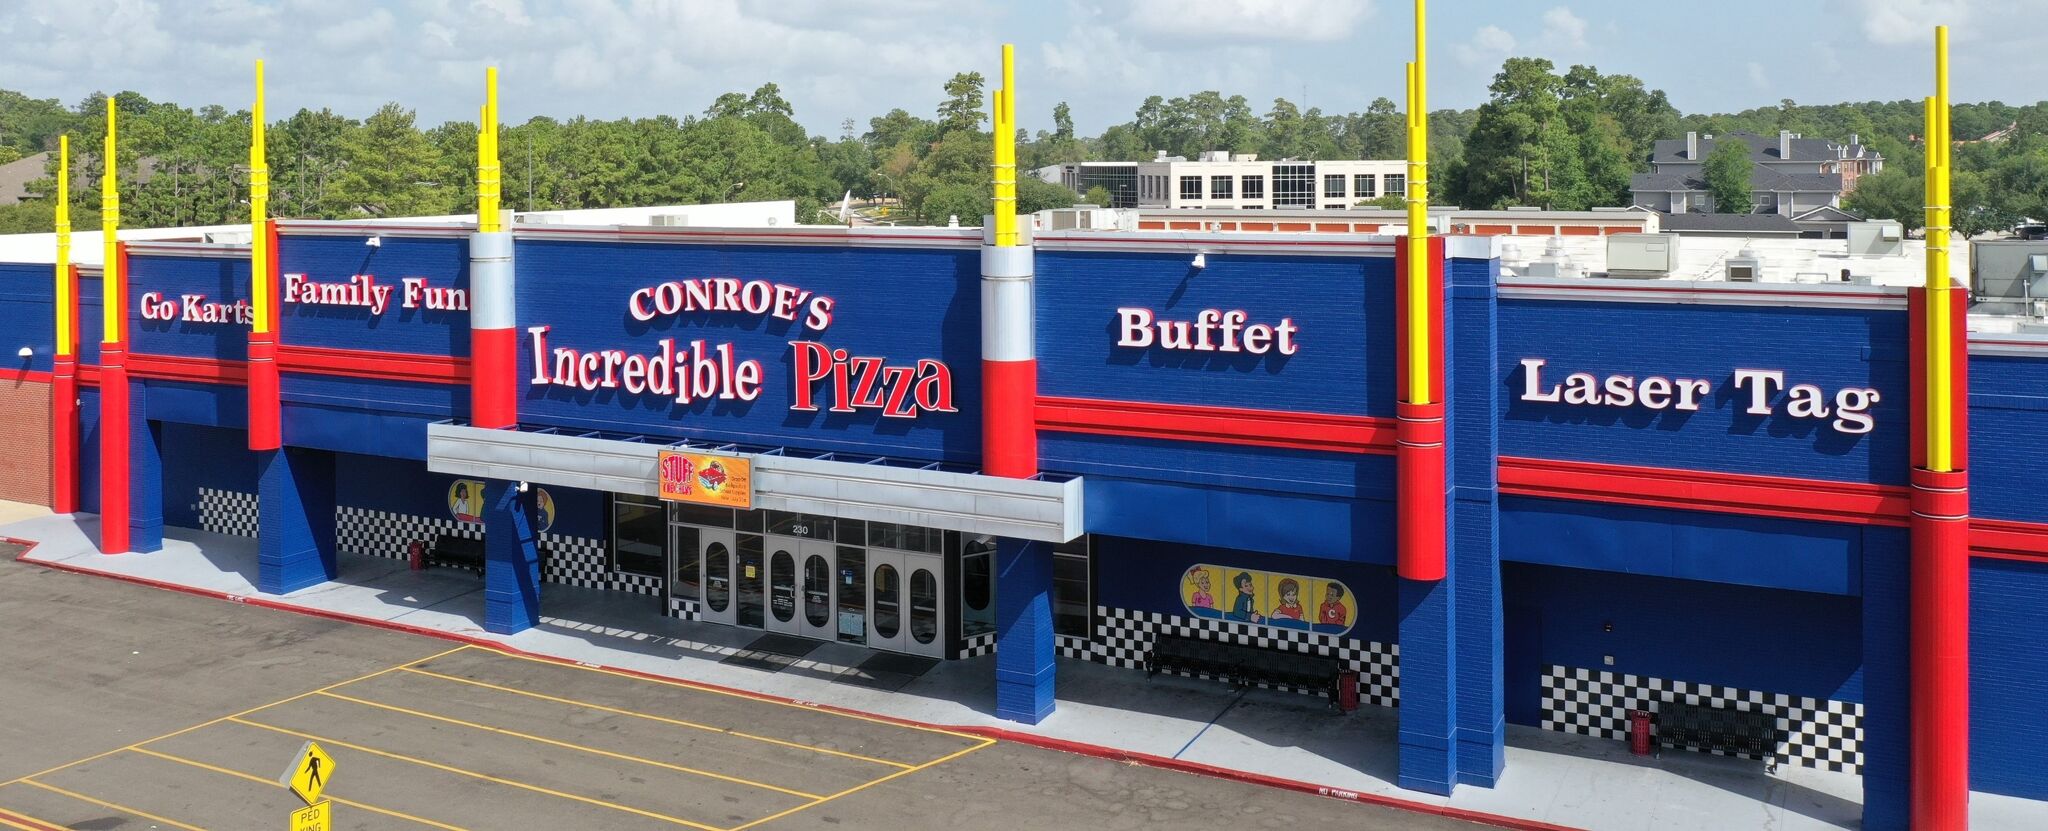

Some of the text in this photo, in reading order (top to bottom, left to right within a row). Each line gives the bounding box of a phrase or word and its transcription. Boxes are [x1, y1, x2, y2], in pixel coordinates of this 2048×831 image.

[140, 292, 254, 325] Go Karts
[284, 272, 469, 316] Family Fun
[629, 277, 834, 331] CONROE'S
[1117, 307, 1298, 355] Buffet
[528, 325, 959, 418] Incredible Pizza
[1520, 358, 1881, 434] Laser Tag
[662, 455, 694, 483] STUFF
[792, 524, 808, 535] 230
[300, 808, 320, 824] PED
